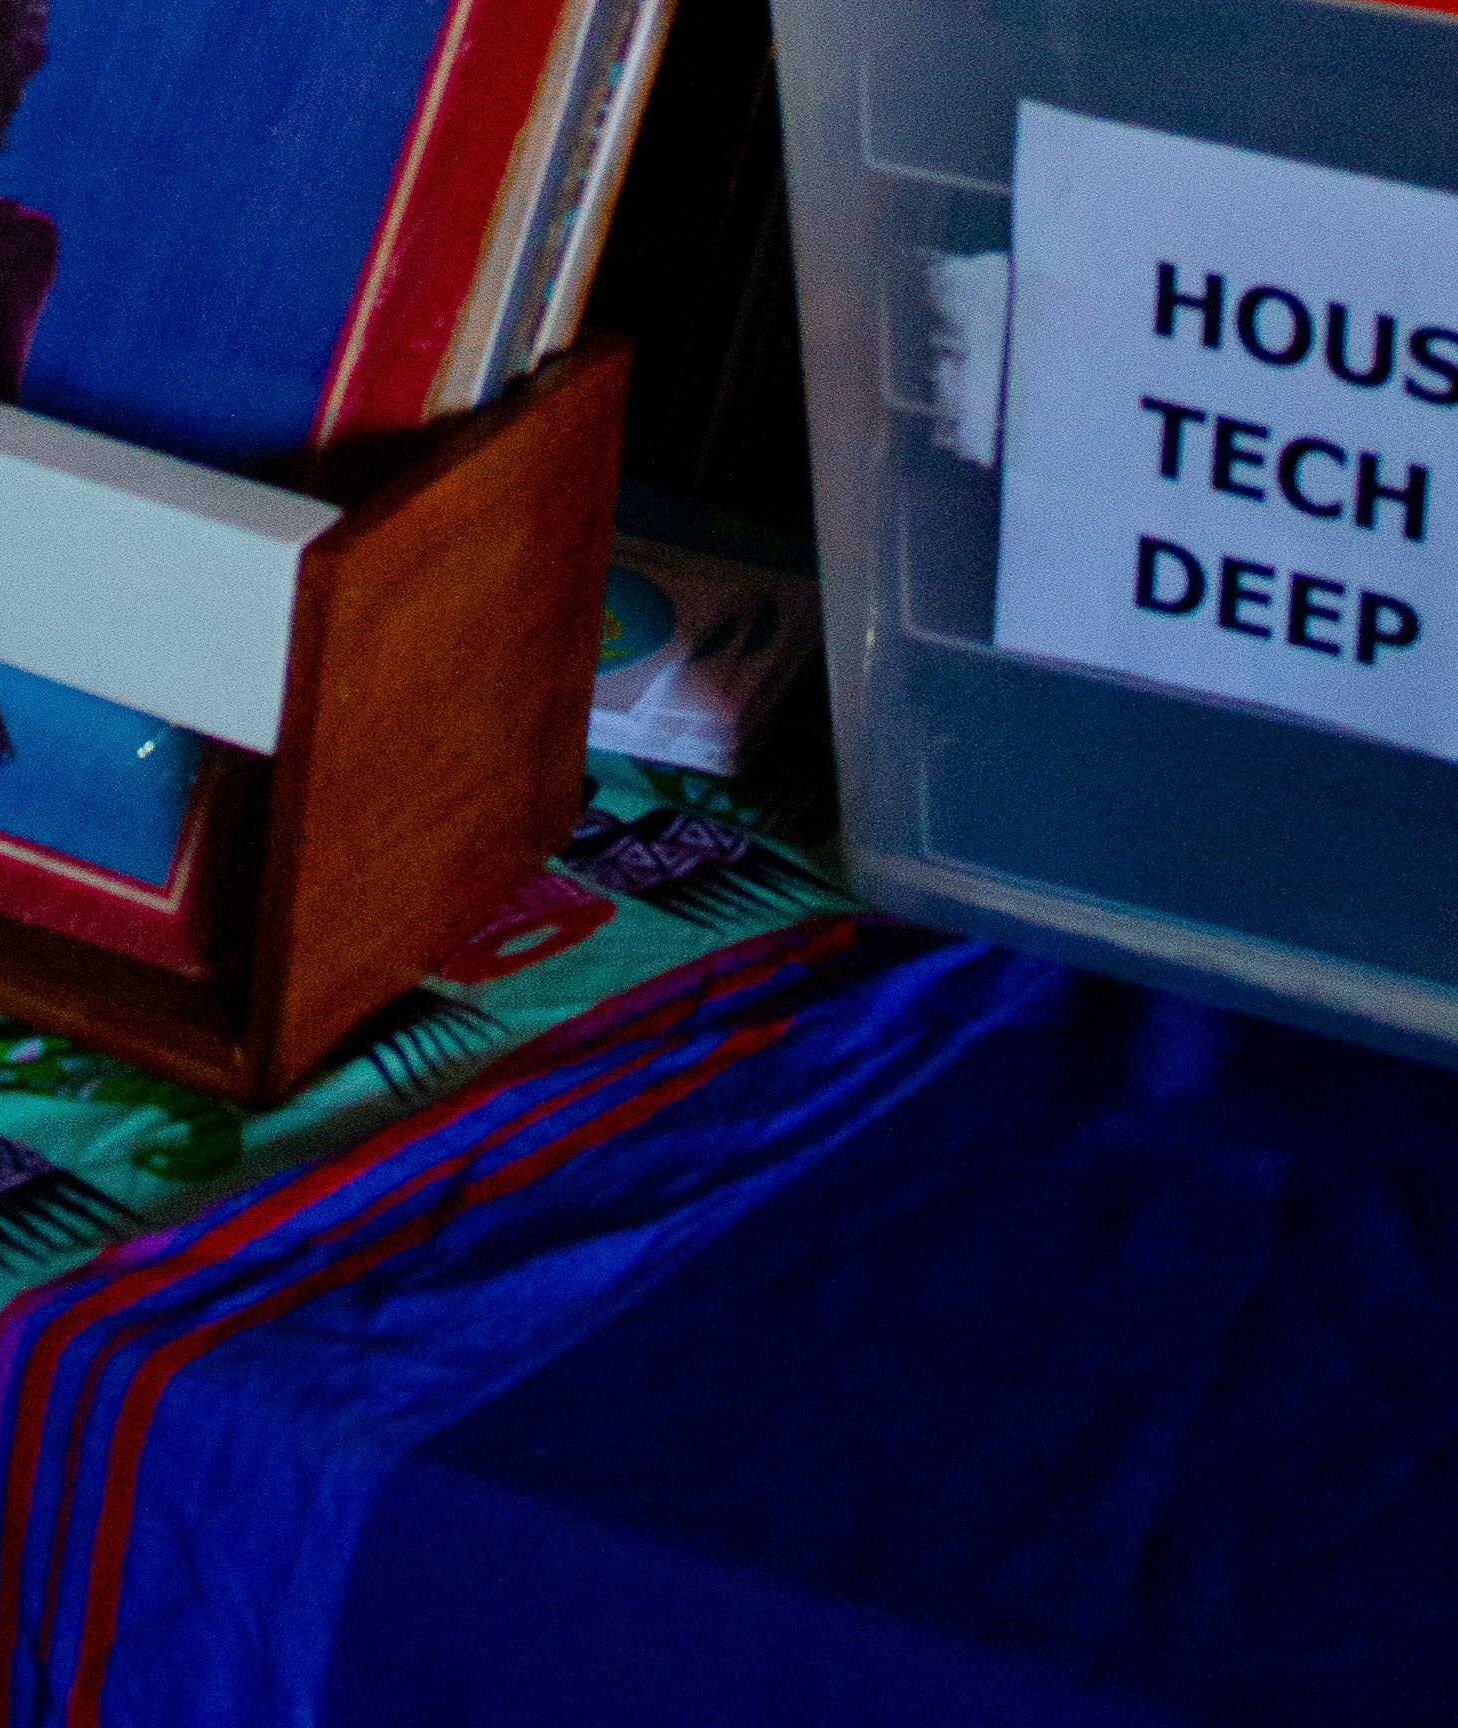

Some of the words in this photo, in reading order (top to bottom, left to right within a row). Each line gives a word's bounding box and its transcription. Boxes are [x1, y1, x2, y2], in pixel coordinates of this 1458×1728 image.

[1152, 260, 1458, 408] HOUS
[1140, 394, 1432, 543] TECH
[1135, 532, 1422, 666] DEEP
